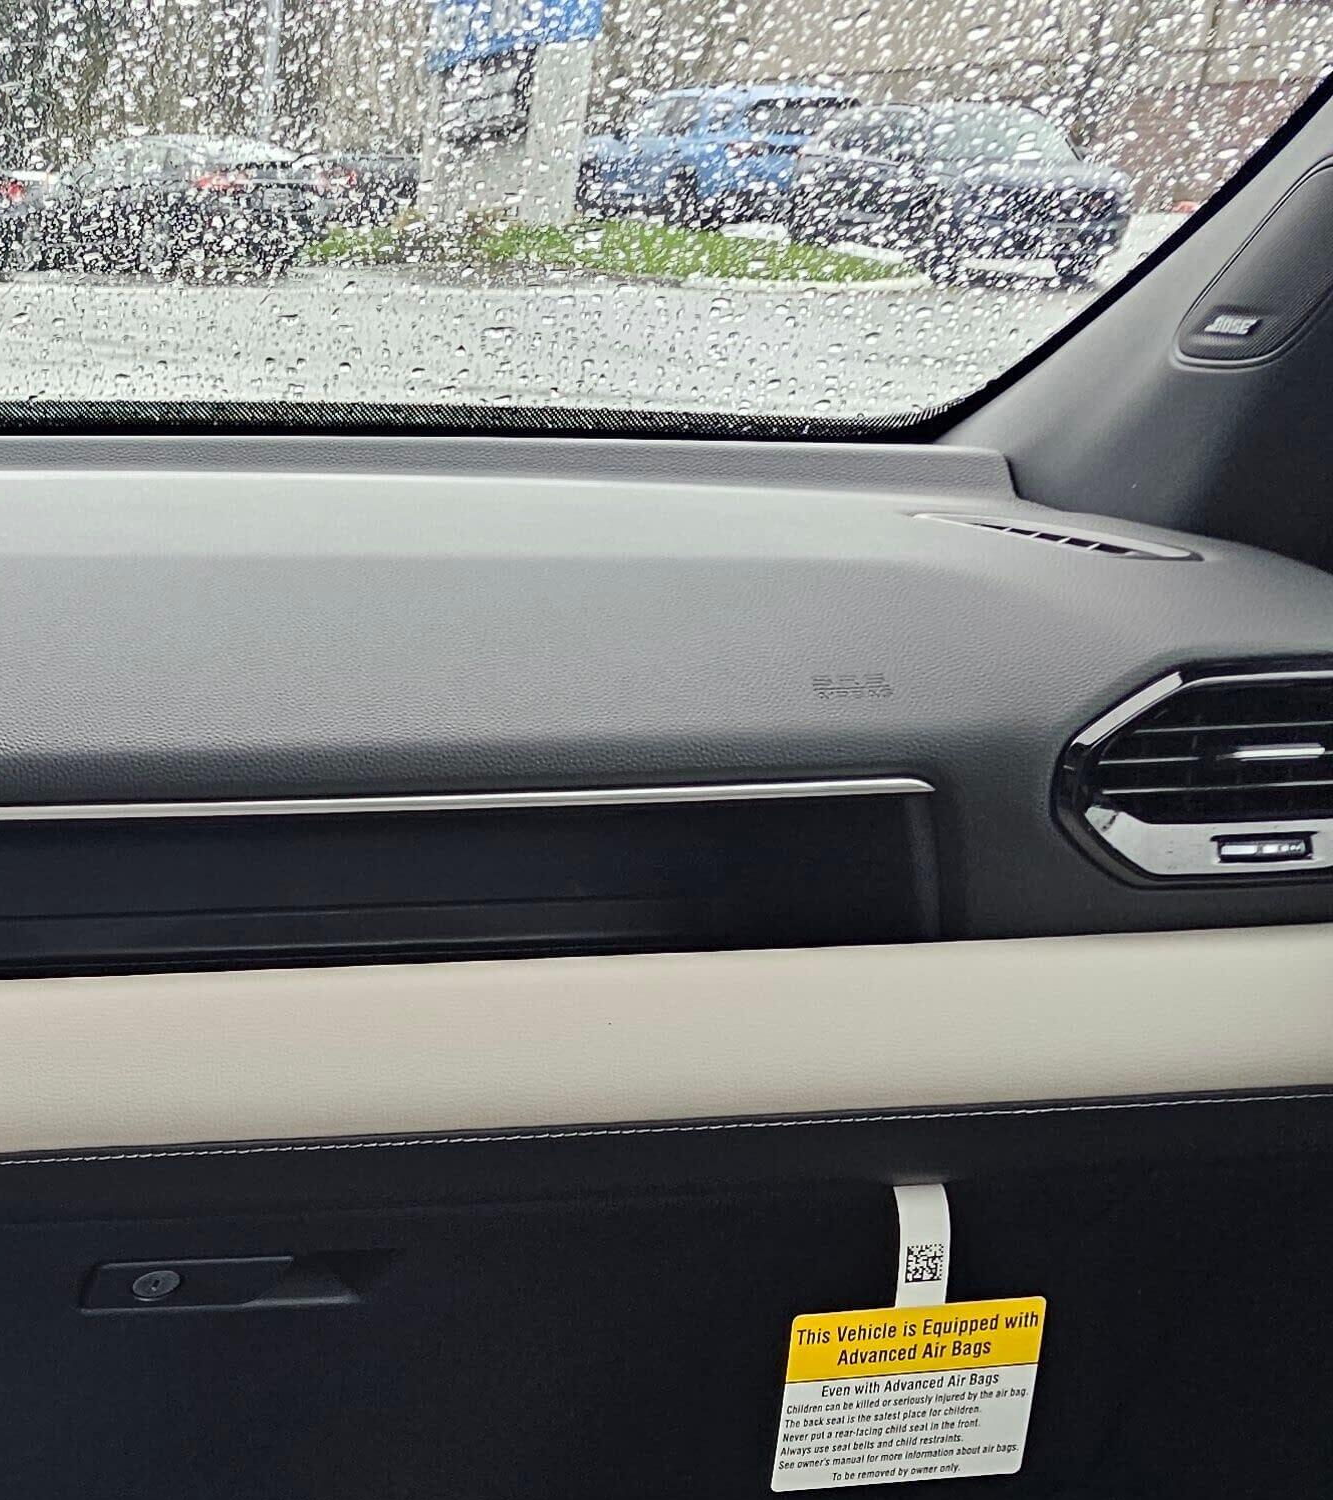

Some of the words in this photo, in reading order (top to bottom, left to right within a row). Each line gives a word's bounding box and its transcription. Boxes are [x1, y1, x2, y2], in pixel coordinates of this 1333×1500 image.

[797, 1328, 830, 1346] This
[837, 1324, 897, 1342] Vehicle
[903, 1322, 917, 1337] is
[923, 1314, 999, 1338] Equipped
[1005, 1311, 1039, 1329] with
[837, 1344, 917, 1366] Advanced
[922, 1342, 947, 1359] Air
[952, 1339, 991, 1358] Bags
[821, 1384, 851, 1398] Even
[855, 1382, 880, 1394] with
[884, 1375, 944, 1393] Advanced
[947, 1375, 967, 1388] Air
[969, 1373, 999, 1387] Bags
[787, 1404, 823, 1414] Children
[825, 1402, 841, 1412] can
[843, 1402, 853, 1410] be
[855, 1398, 879, 1409] killed
[882, 1399, 891, 1407] or
[893, 1394, 933, 1406] seriously
[935, 1391, 965, 1404] injured
[967, 1391, 978, 1401] by
[980, 1390, 993, 1399] the
[995, 1388, 1009, 1398] air
[1010, 1388, 1029, 1398] bag.
[783, 1433, 808, 1442] Never
[811, 1431, 825, 1442] put
[835, 1426, 883, 1438] rear-facing
[885, 1424, 907, 1434] child
[909, 1422, 927, 1432] seat
[931, 1422, 939, 1430] in
[941, 1421, 955, 1430] the
[957, 1418, 981, 1428] front.
[785, 1419, 801, 1429] The
[803, 1417, 823, 1428] back
[826, 1416, 845, 1426] seat
[847, 1415, 855, 1424] is
[857, 1413, 871, 1422] the
[873, 1411, 901, 1422] safest
[903, 1410, 927, 1420] place
[929, 1408, 941, 1417] for
[944, 1406, 981, 1416] children.
[779, 1461, 795, 1470] See
[797, 1458, 830, 1468] owner's
[833, 1455, 865, 1466] manual
[867, 1454, 879, 1463] for
[881, 1452, 903, 1461] more
[905, 1448, 953, 1460] information
[956, 1446, 981, 1455] about
[983, 1444, 995, 1454] air
[997, 1444, 1019, 1453] bags.
[780, 1447, 811, 1457] Always
[814, 1444, 829, 1454] use
[832, 1443, 851, 1452] seat
[853, 1441, 875, 1450] belts
[877, 1439, 893, 1448] and
[896, 1437, 917, 1446] child
[919, 1434, 963, 1446] restraints.
[833, 1472, 842, 1482] To
[844, 1471, 855, 1480] be
[857, 1468, 895, 1478] removed
[897, 1467, 909, 1478] by
[911, 1466, 937, 1475] owner
[940, 1463, 961, 1472] only.
